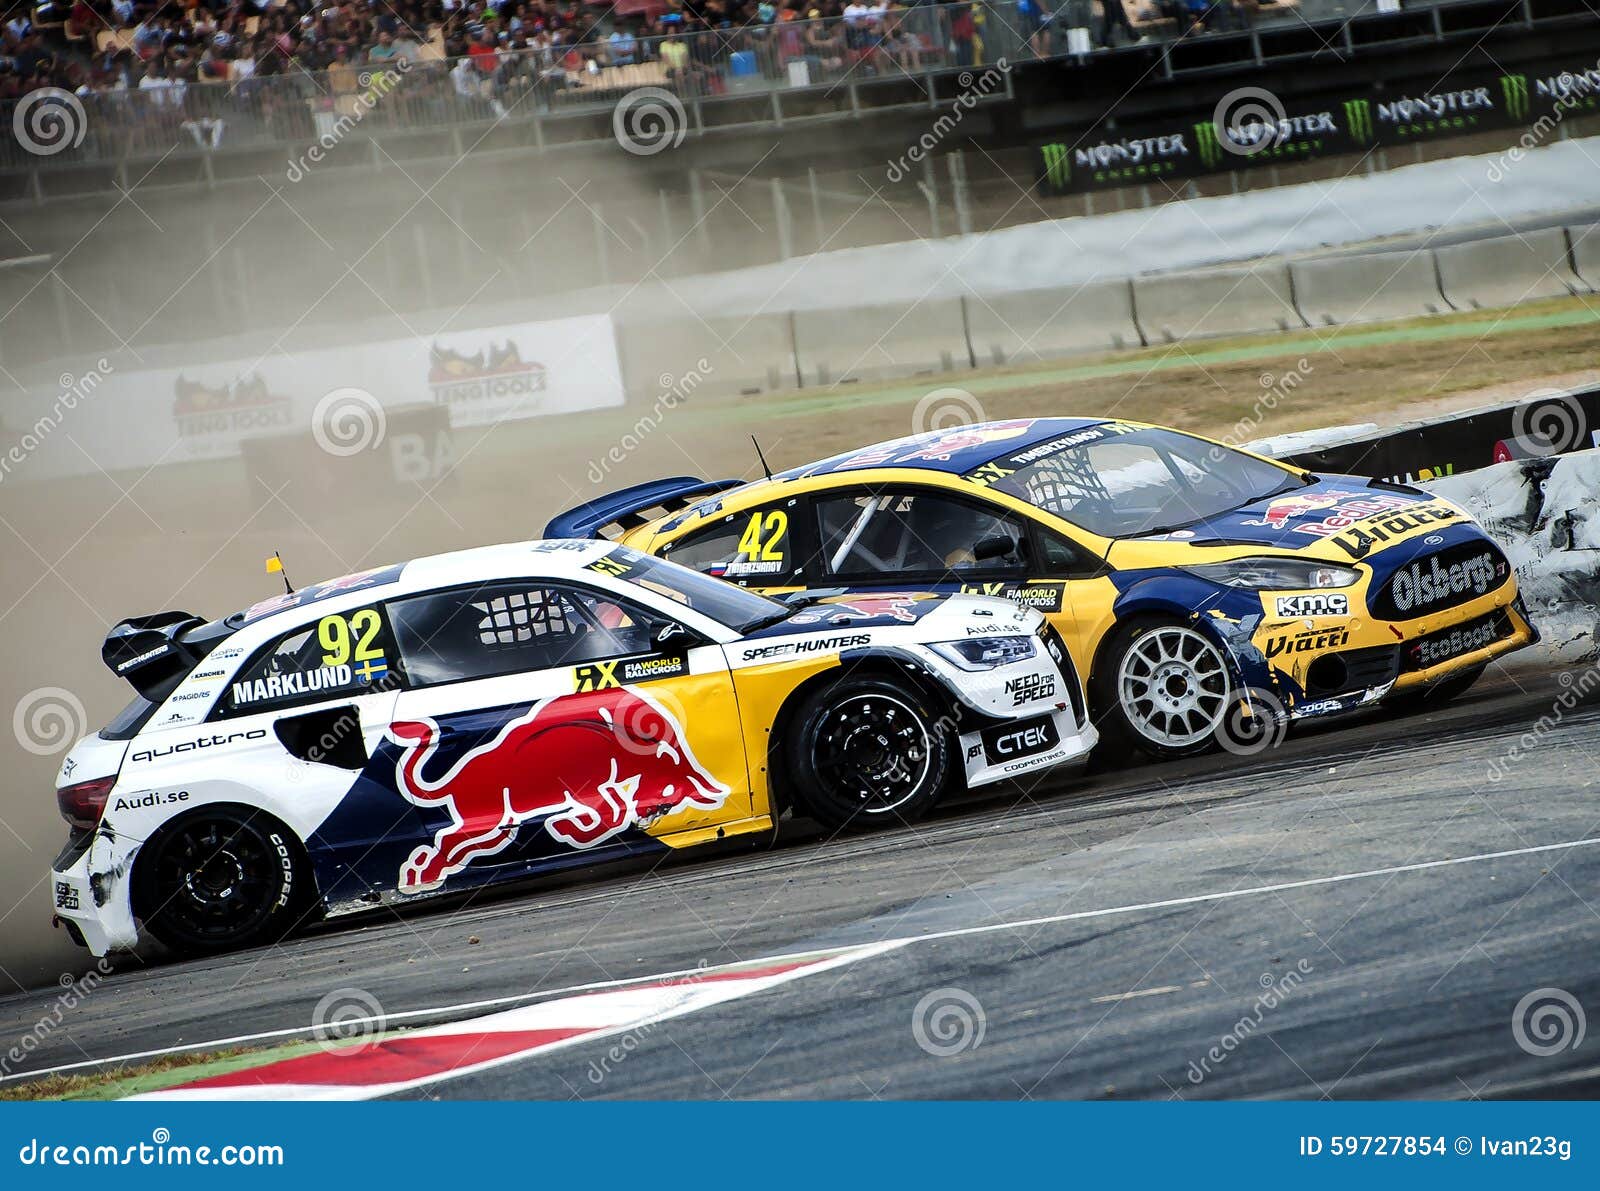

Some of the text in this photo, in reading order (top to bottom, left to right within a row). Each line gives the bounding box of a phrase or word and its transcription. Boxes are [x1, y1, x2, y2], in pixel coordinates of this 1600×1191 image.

[1377, 86, 1494, 122] MONSTER
[1226, 111, 1338, 146] MONSTER
[1075, 133, 1188, 169] MONSTER
[738, 510, 788, 562] 42
[1392, 552, 1496, 612] Olsbergs
[966, 623, 1022, 636] Audi.se
[1282, 608, 1344, 617] WHEELS
[317, 608, 385, 667] 92
[232, 664, 352, 705] MARKLUND
[625, 663, 682, 679] RALLYCROSS
[1004, 673, 1055, 695] NEED FOR
[1013, 684, 1055, 707] SPEED
[132, 729, 267, 762] quattro
[996, 724, 1049, 754] CTEK
[114, 789, 190, 812] Audi.se
[269, 833, 292, 907] COOPER
